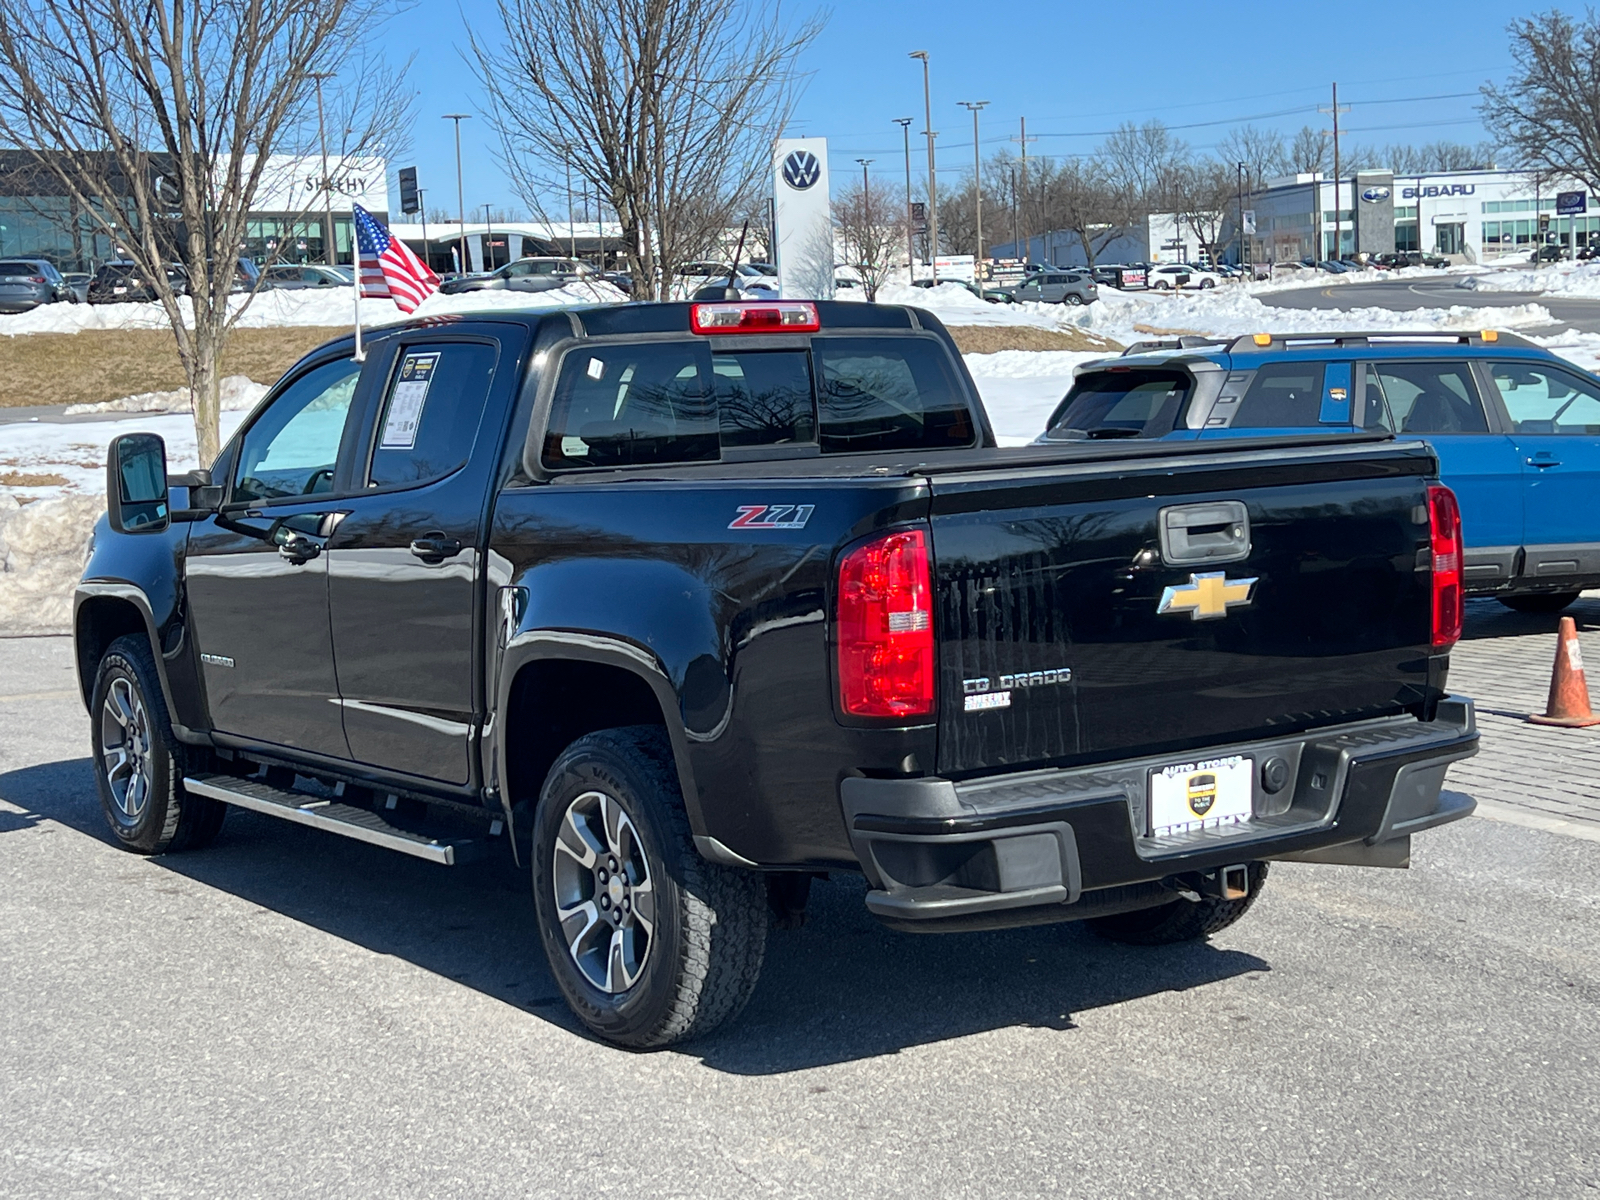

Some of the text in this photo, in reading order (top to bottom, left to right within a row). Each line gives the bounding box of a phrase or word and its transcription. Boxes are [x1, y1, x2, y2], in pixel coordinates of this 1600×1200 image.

[1402, 184, 1475, 199] SUBARU
[727, 504, 815, 529] Z71
[1162, 763, 1194, 775] AUTO
